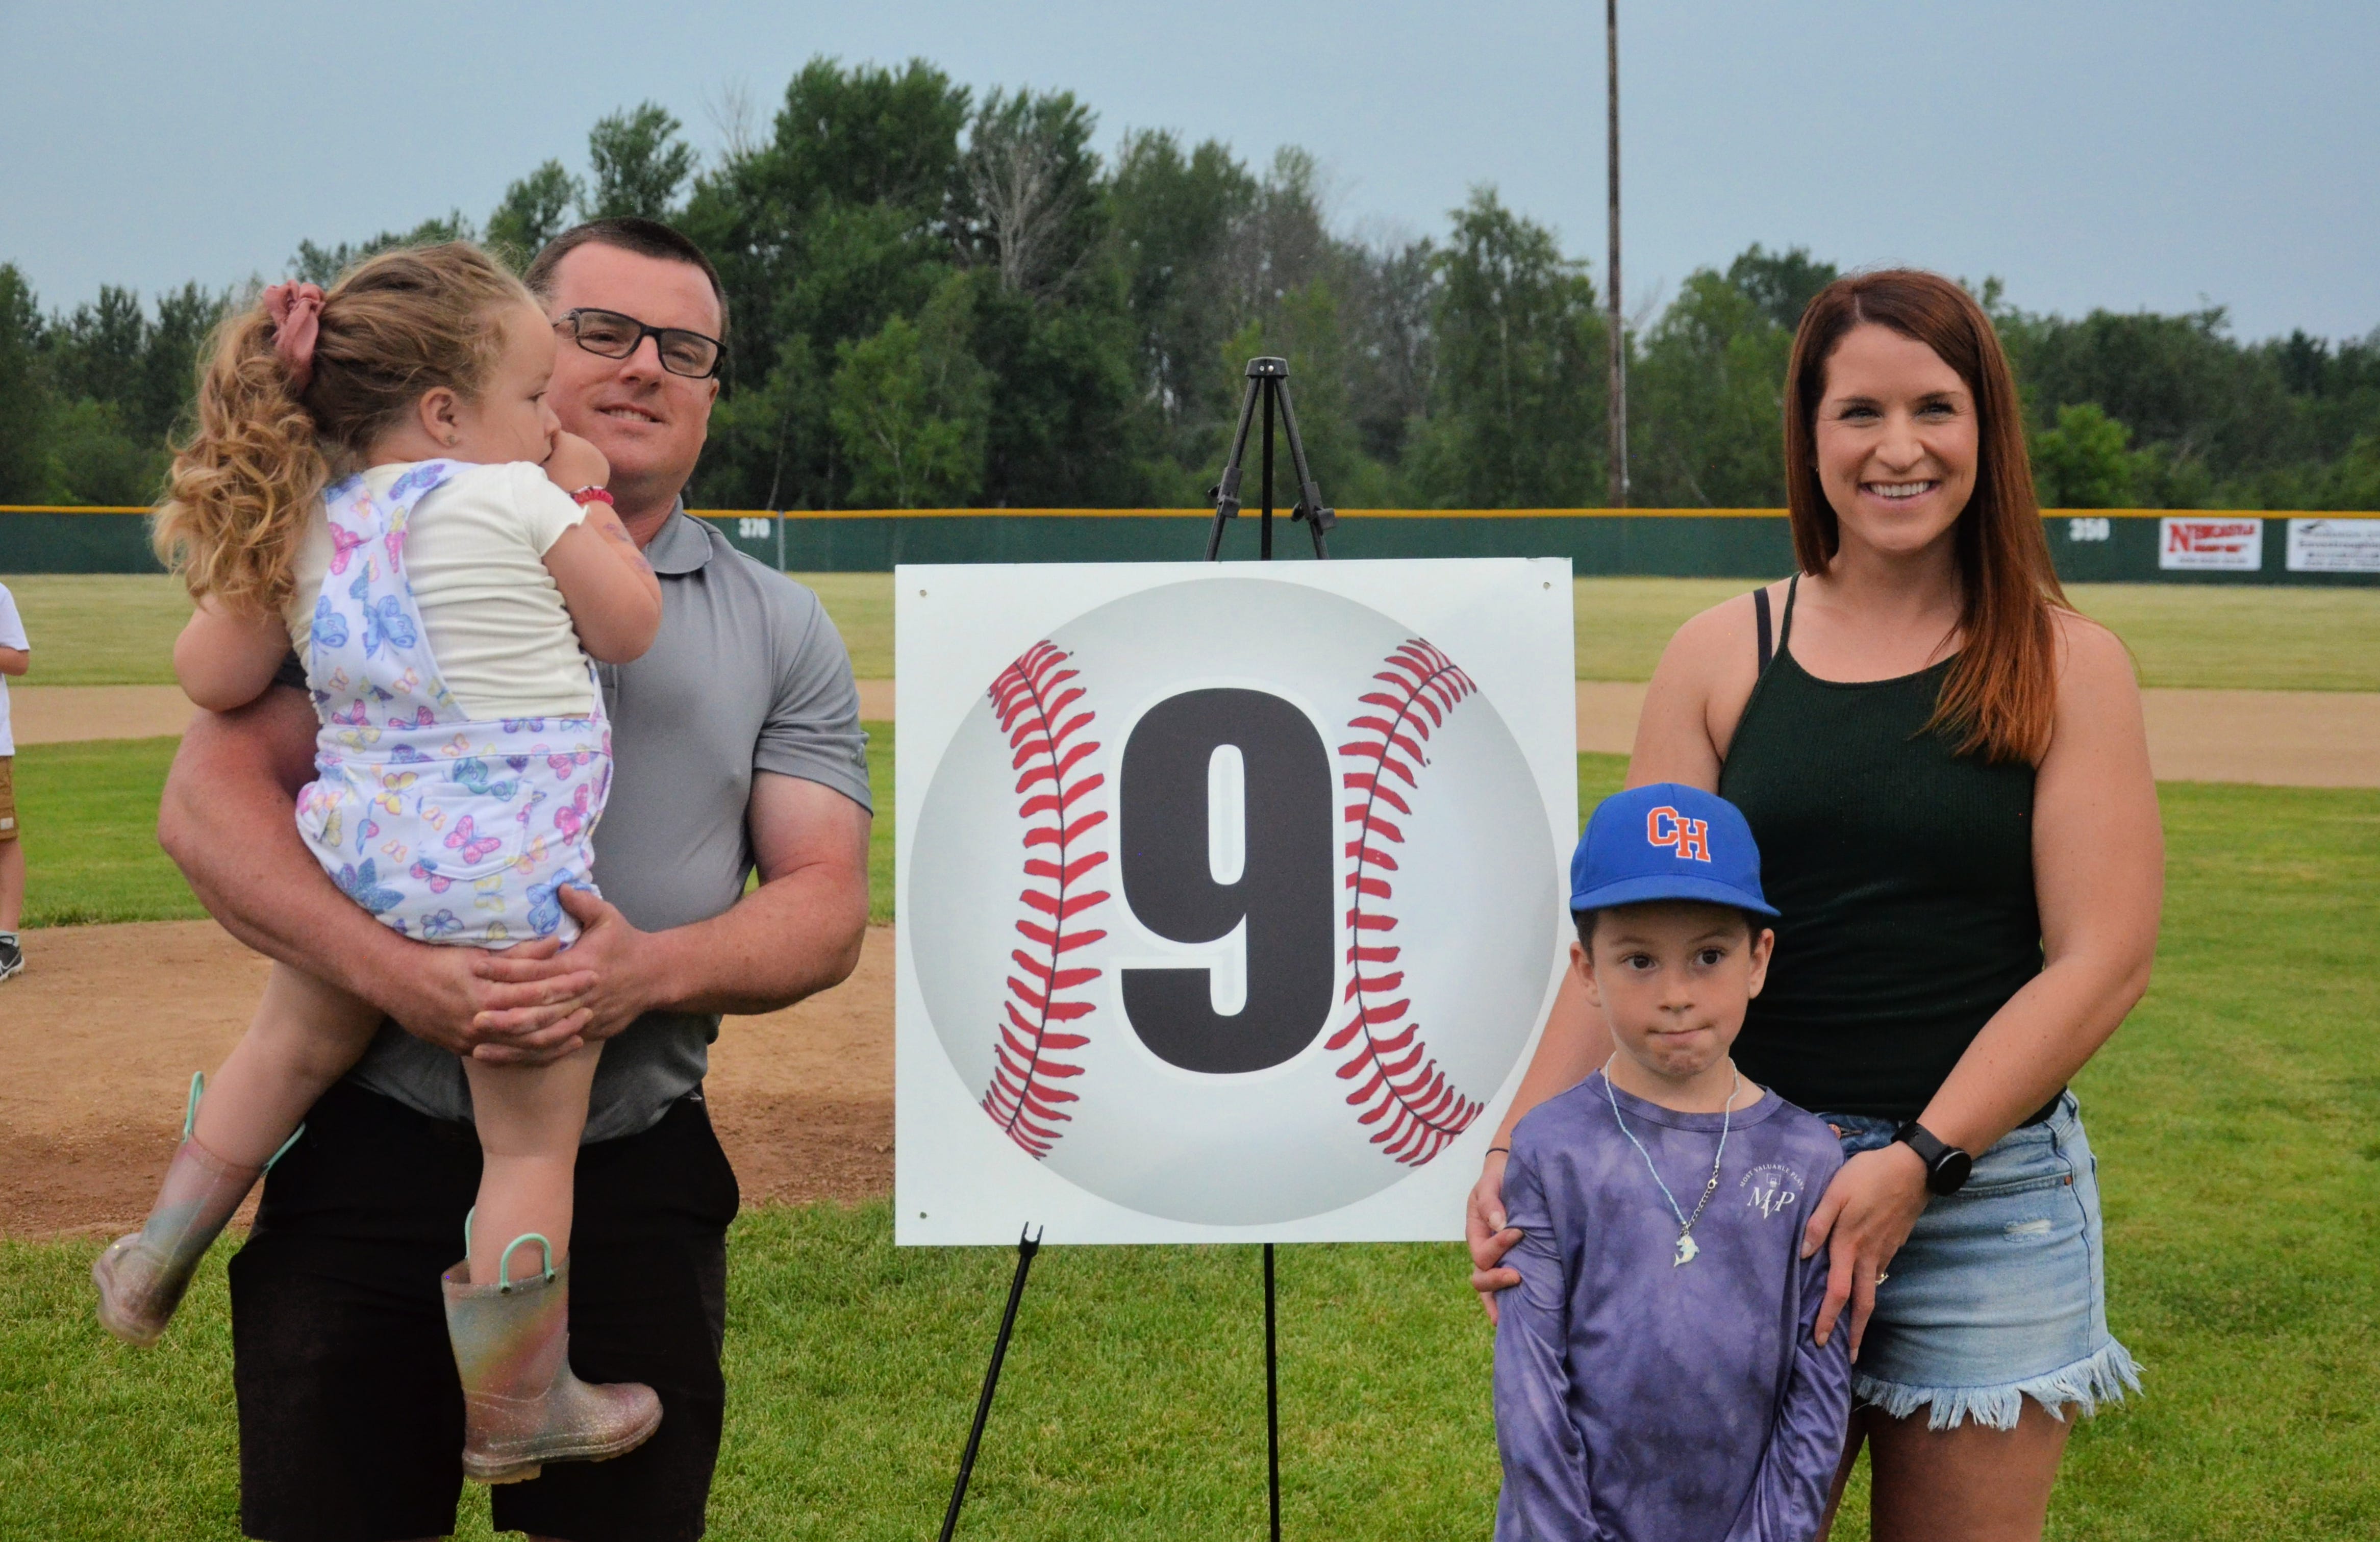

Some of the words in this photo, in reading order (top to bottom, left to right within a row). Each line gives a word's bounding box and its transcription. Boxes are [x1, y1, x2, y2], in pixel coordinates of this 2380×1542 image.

[739, 518, 770, 539] 370
[1647, 806, 1711, 863] CH
[1120, 688, 1335, 1074] 9
[1740, 1170, 1753, 1188] MOST
[1746, 1186, 1795, 1220] MVP
